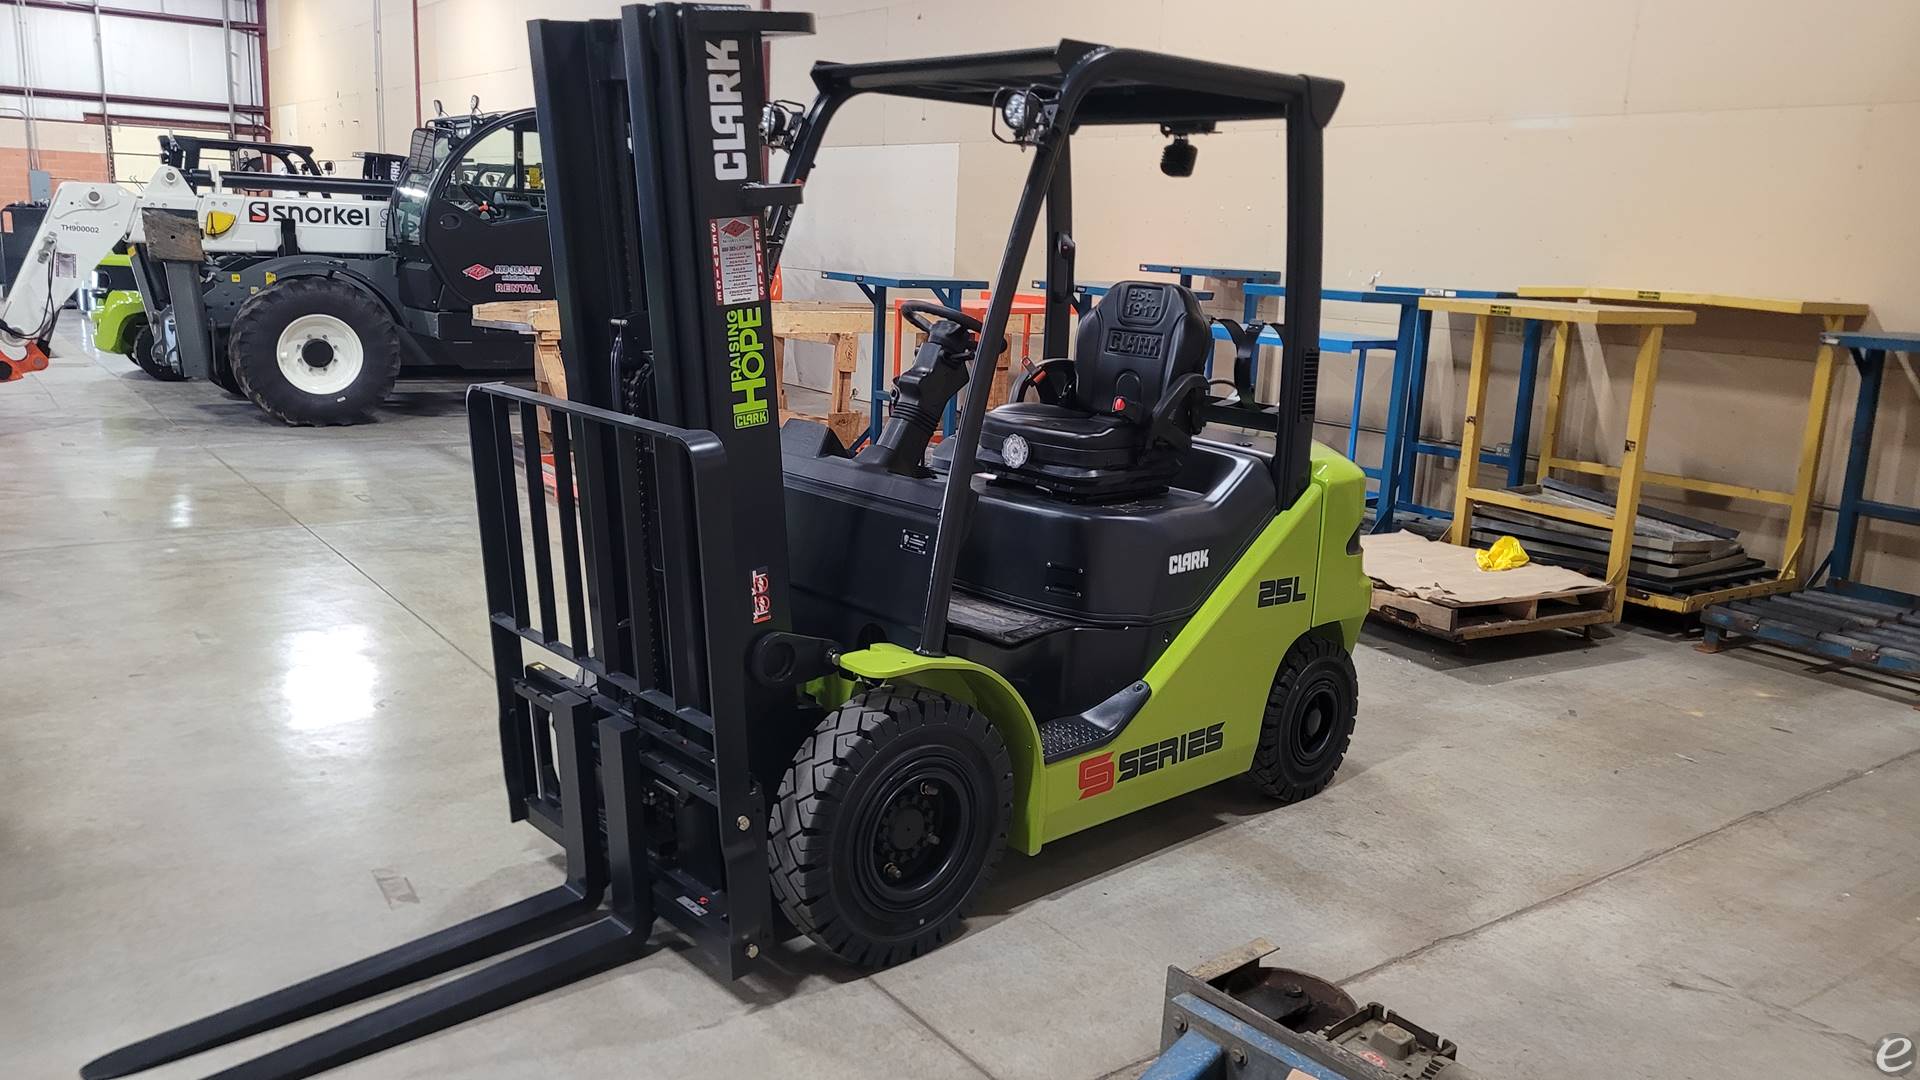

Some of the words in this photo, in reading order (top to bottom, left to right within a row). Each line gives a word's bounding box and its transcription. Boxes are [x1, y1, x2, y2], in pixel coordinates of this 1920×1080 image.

[705, 39, 748, 181] CLARK
[61, 224, 100, 233] TH900002
[272, 205, 370, 226] snorkel
[711, 223, 722, 300] SERVICE
[753, 219, 765, 296] RENTALS
[495, 283, 541, 293] RENTAL
[1127, 302, 1159, 318] 1917
[727, 310, 742, 380] RAISING
[1108, 331, 1161, 355] CLARK
[731, 307, 768, 413] HOPE
[736, 411, 767, 427] CLARK
[1168, 549, 1209, 575] CLARK
[1257, 576, 1306, 608] 25L
[1117, 721, 1226, 783] SERIES
